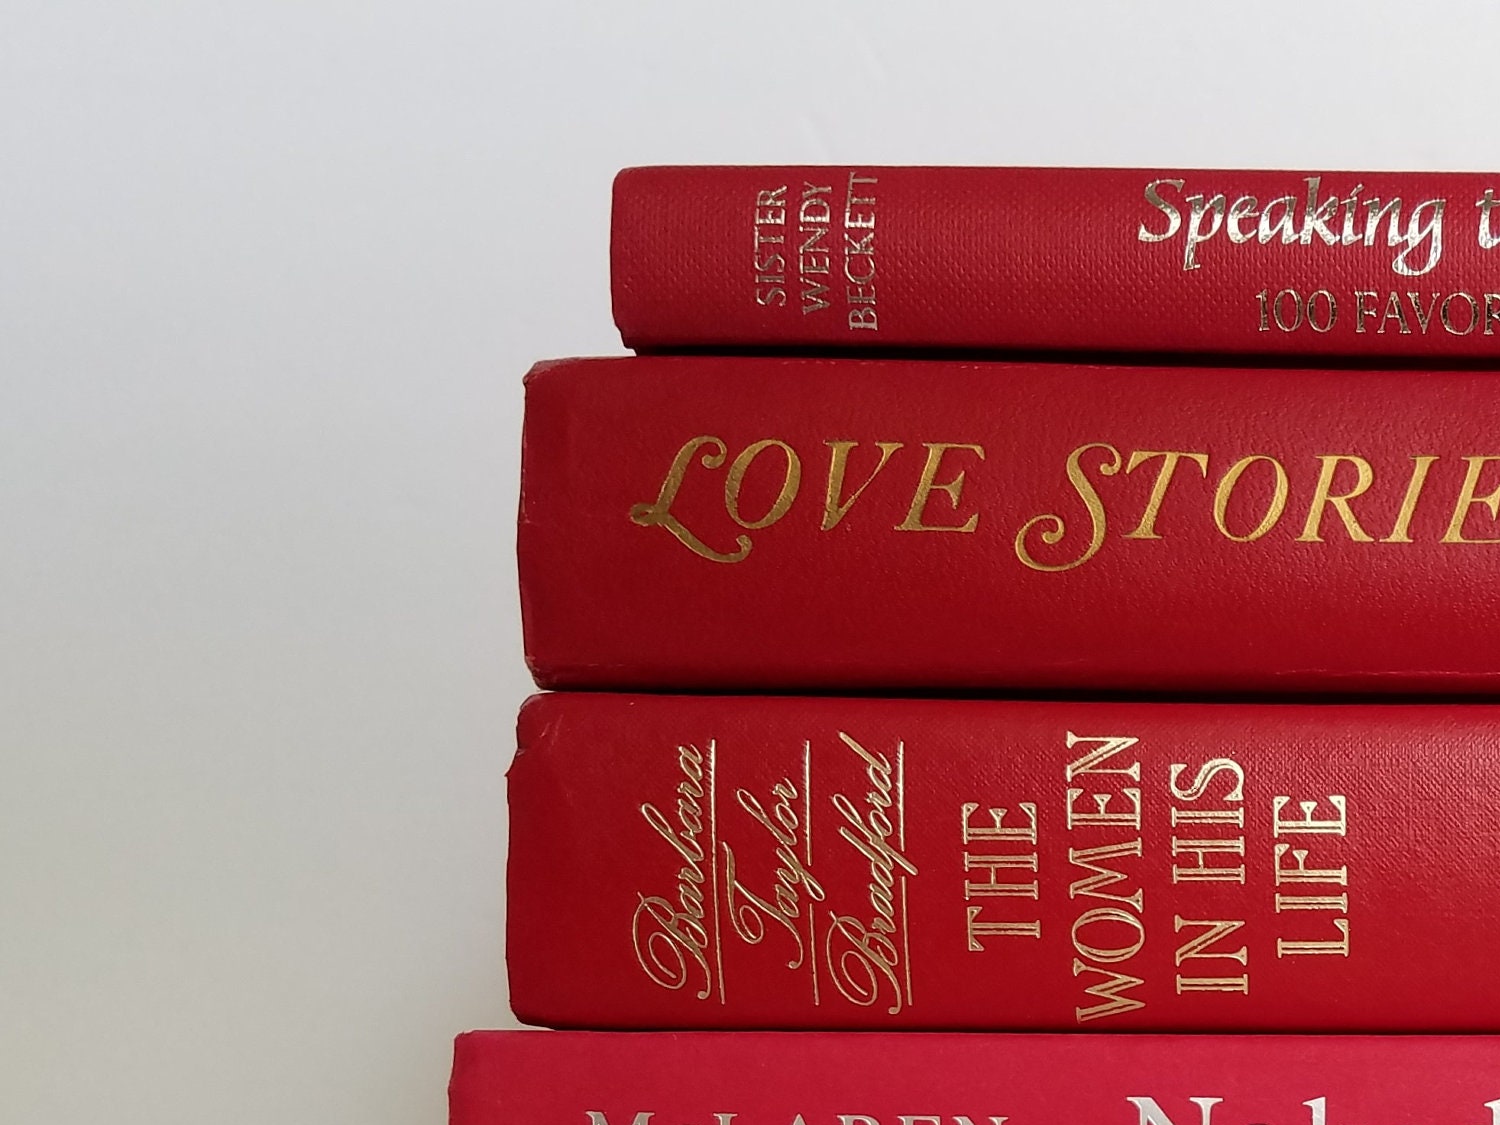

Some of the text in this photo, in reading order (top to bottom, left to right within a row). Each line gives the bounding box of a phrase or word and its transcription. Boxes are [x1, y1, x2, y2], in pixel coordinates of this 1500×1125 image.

[757, 184, 788, 308] SISTER
[800, 181, 834, 315] WENDY
[844, 171, 879, 332] BECKETT
[1138, 176, 1447, 276] Speaking
[1255, 289, 1338, 334] 100
[629, 435, 986, 564] LOVE
[632, 743, 712, 1000] Barbara
[721, 777, 825, 969] Taylor
[826, 731, 918, 1014] Bradford
[960, 802, 1041, 951] THE
[1066, 730, 1147, 1024] WOMEN
[1170, 757, 1249, 996] IN HIS
[1273, 795, 1350, 958] LIFE
